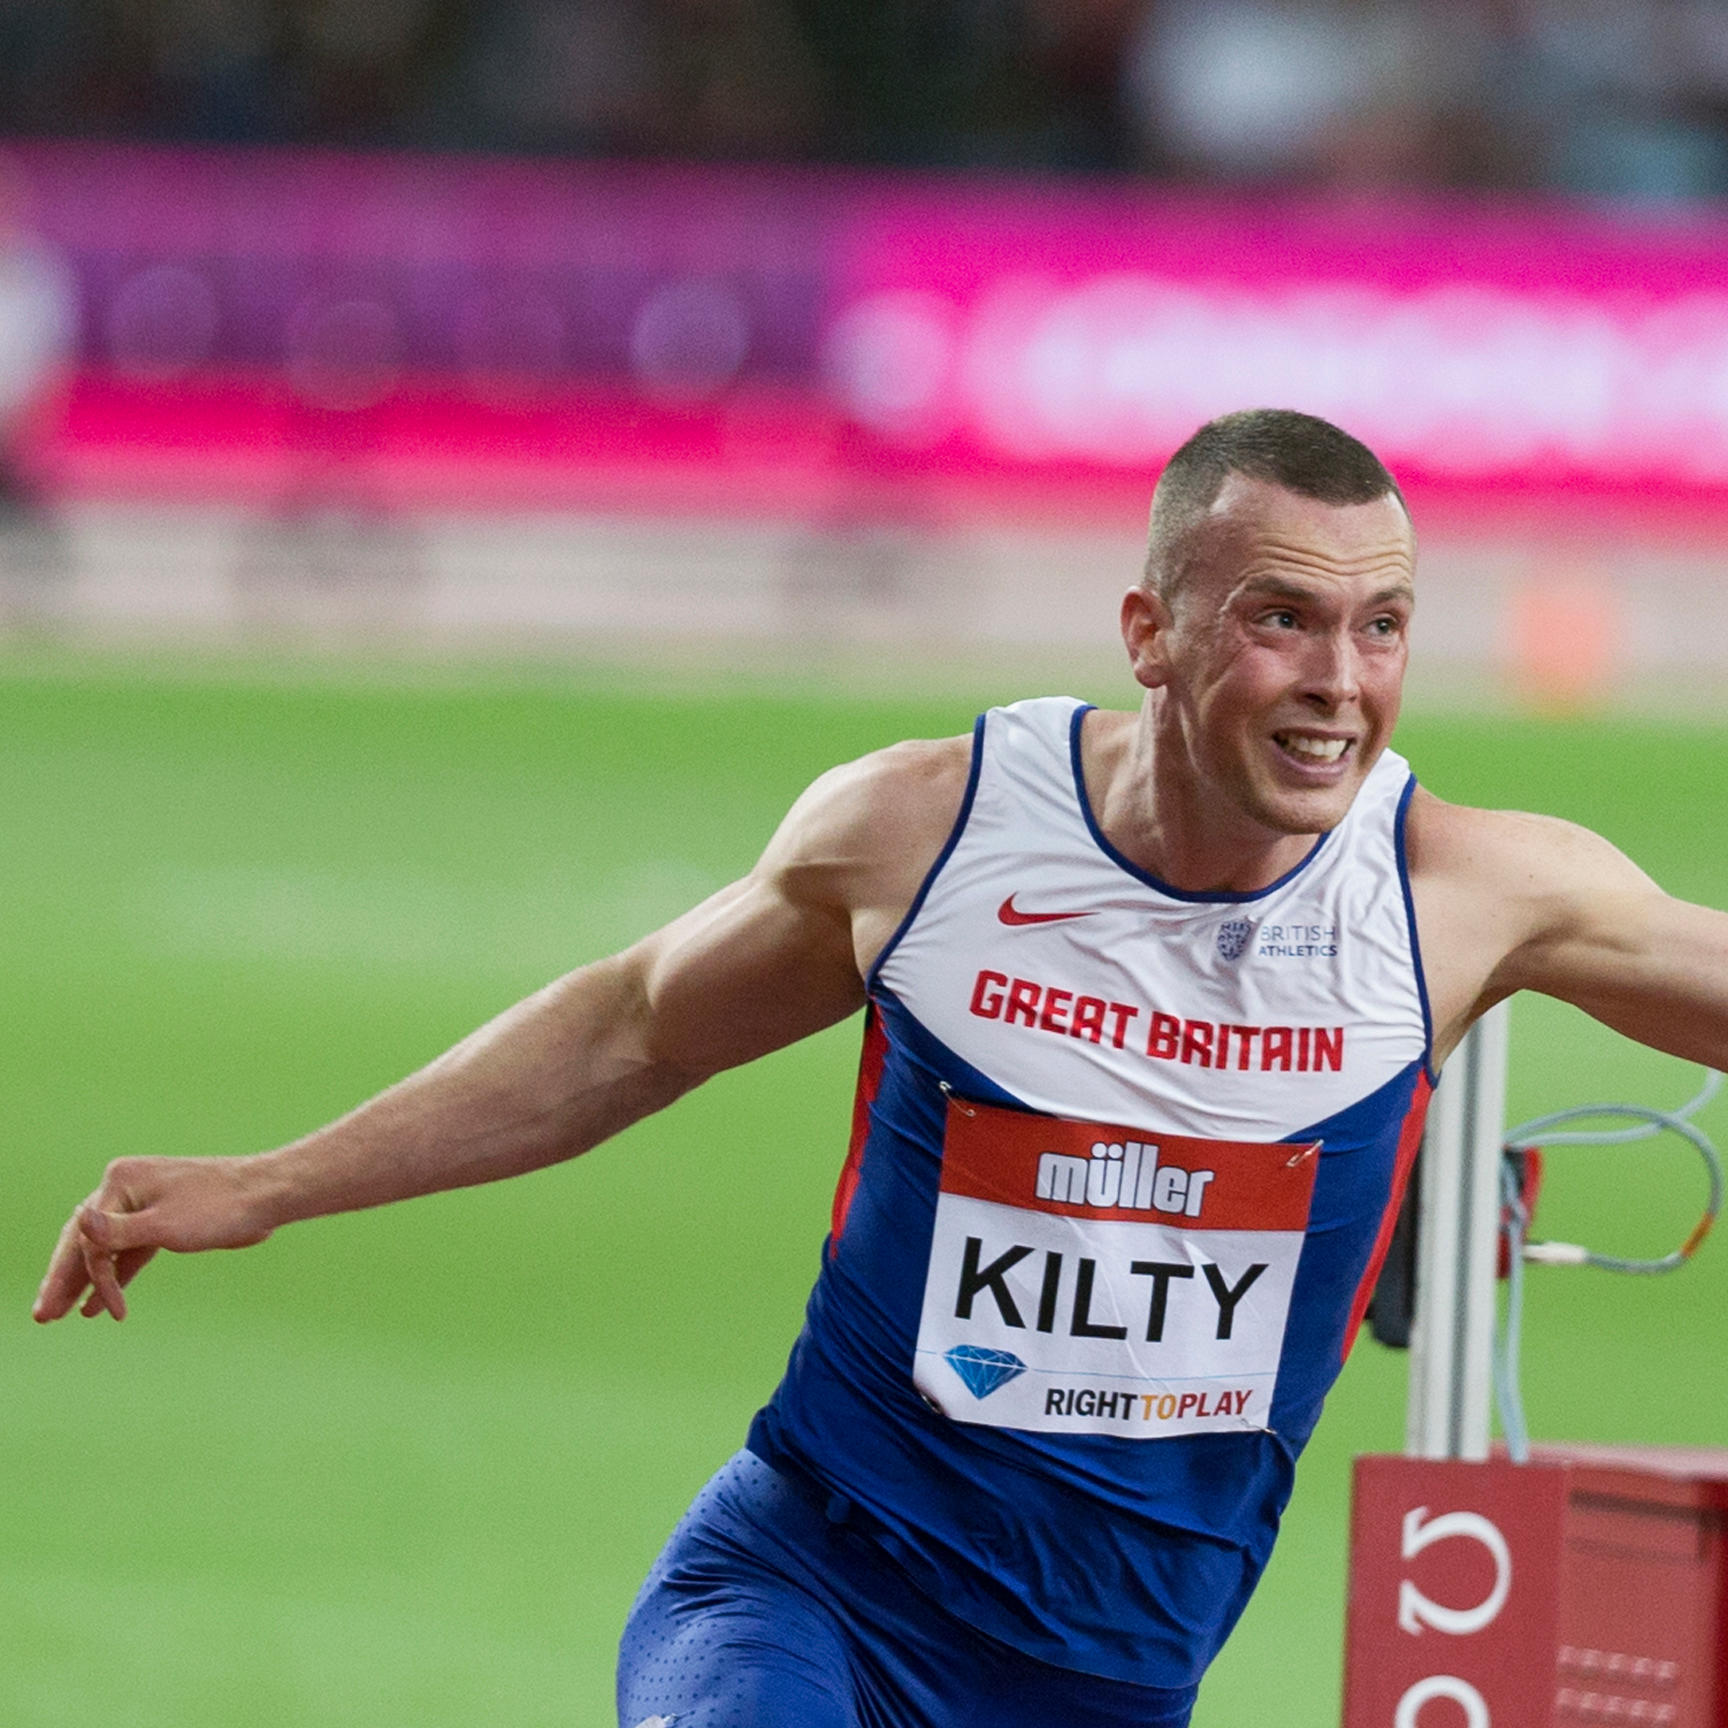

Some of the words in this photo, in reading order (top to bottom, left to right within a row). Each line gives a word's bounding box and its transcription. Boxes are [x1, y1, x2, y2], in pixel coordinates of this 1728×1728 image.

[1258, 944, 1339, 957] ATHLETICS
[1260, 925, 1337, 941] BRITISH
[969, 969, 1138, 1050] GREAT
[1147, 1011, 1344, 1072] BRITAIN
[1035, 1141, 1215, 1217] müller
[954, 1236, 1270, 1342] KILTY
